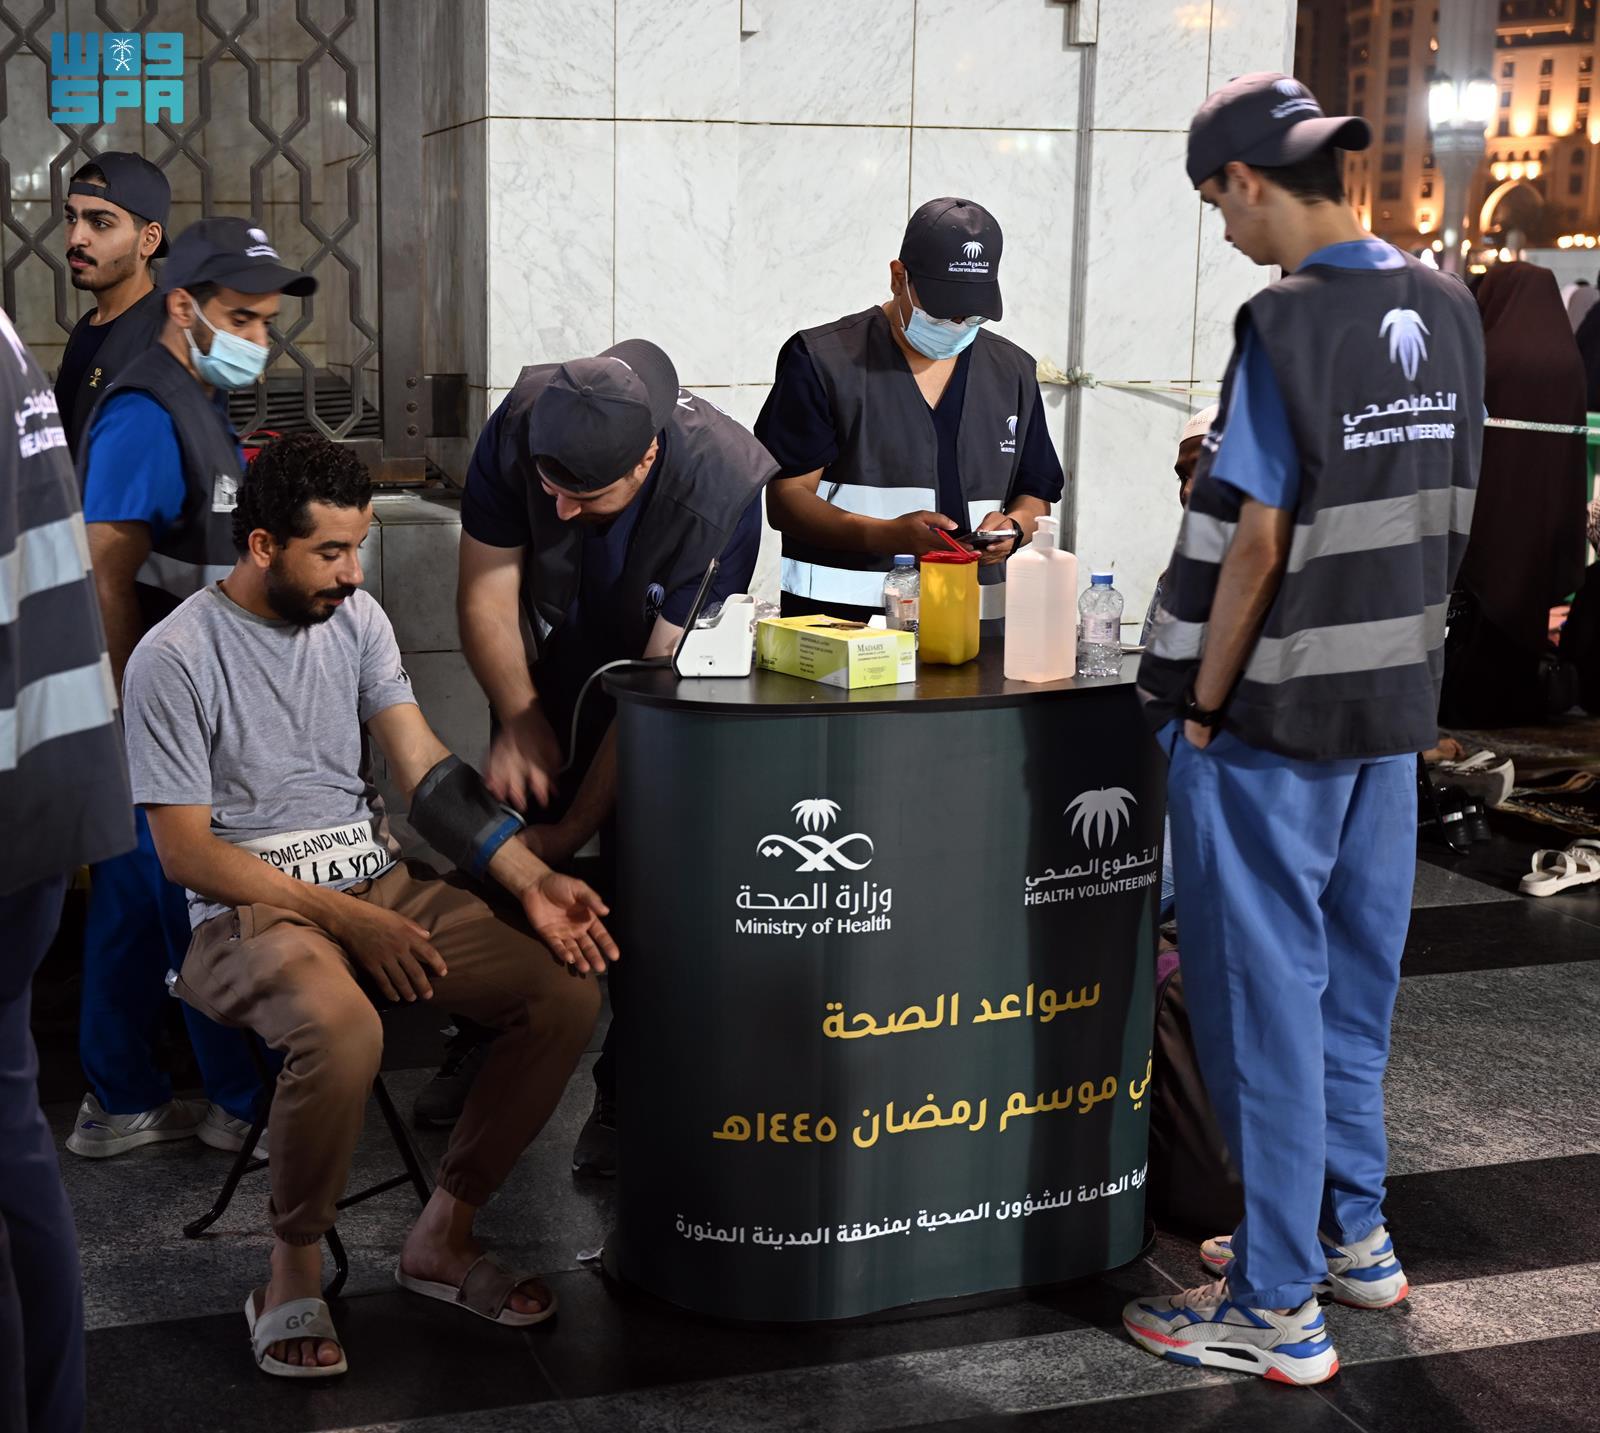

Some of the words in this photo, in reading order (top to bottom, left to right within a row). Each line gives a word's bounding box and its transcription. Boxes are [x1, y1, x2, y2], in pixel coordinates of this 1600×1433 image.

[1343, 426, 1405, 451] HEALTH
[1025, 858, 1099, 892] الصحي
[1101, 845, 1159, 880] التطوع
[736, 882, 827, 910] الصحة
[835, 881, 892, 915] وزارة
[1024, 887, 1075, 906] HEALTH
[1078, 870, 1158, 899] VOLUNTEERING
[735, 917, 807, 939] Ministry
[812, 917, 834, 934] of
[837, 914, 892, 934] Health
[822, 992, 960, 1040] الصحة
[972, 981, 1101, 1024] سواعد
[999, 1075, 1118, 1132] موسم
[852, 1093, 988, 1149] رمضان
[1077, 1174, 1129, 1203] العامة
[916, 1202, 990, 1232] الصحية
[995, 1189, 1073, 1220] للشؤون
[675, 1213, 745, 1244] المنورة
[752, 1226, 830, 1251] المدينة
[836, 1217, 911, 1243] بمنطقة
